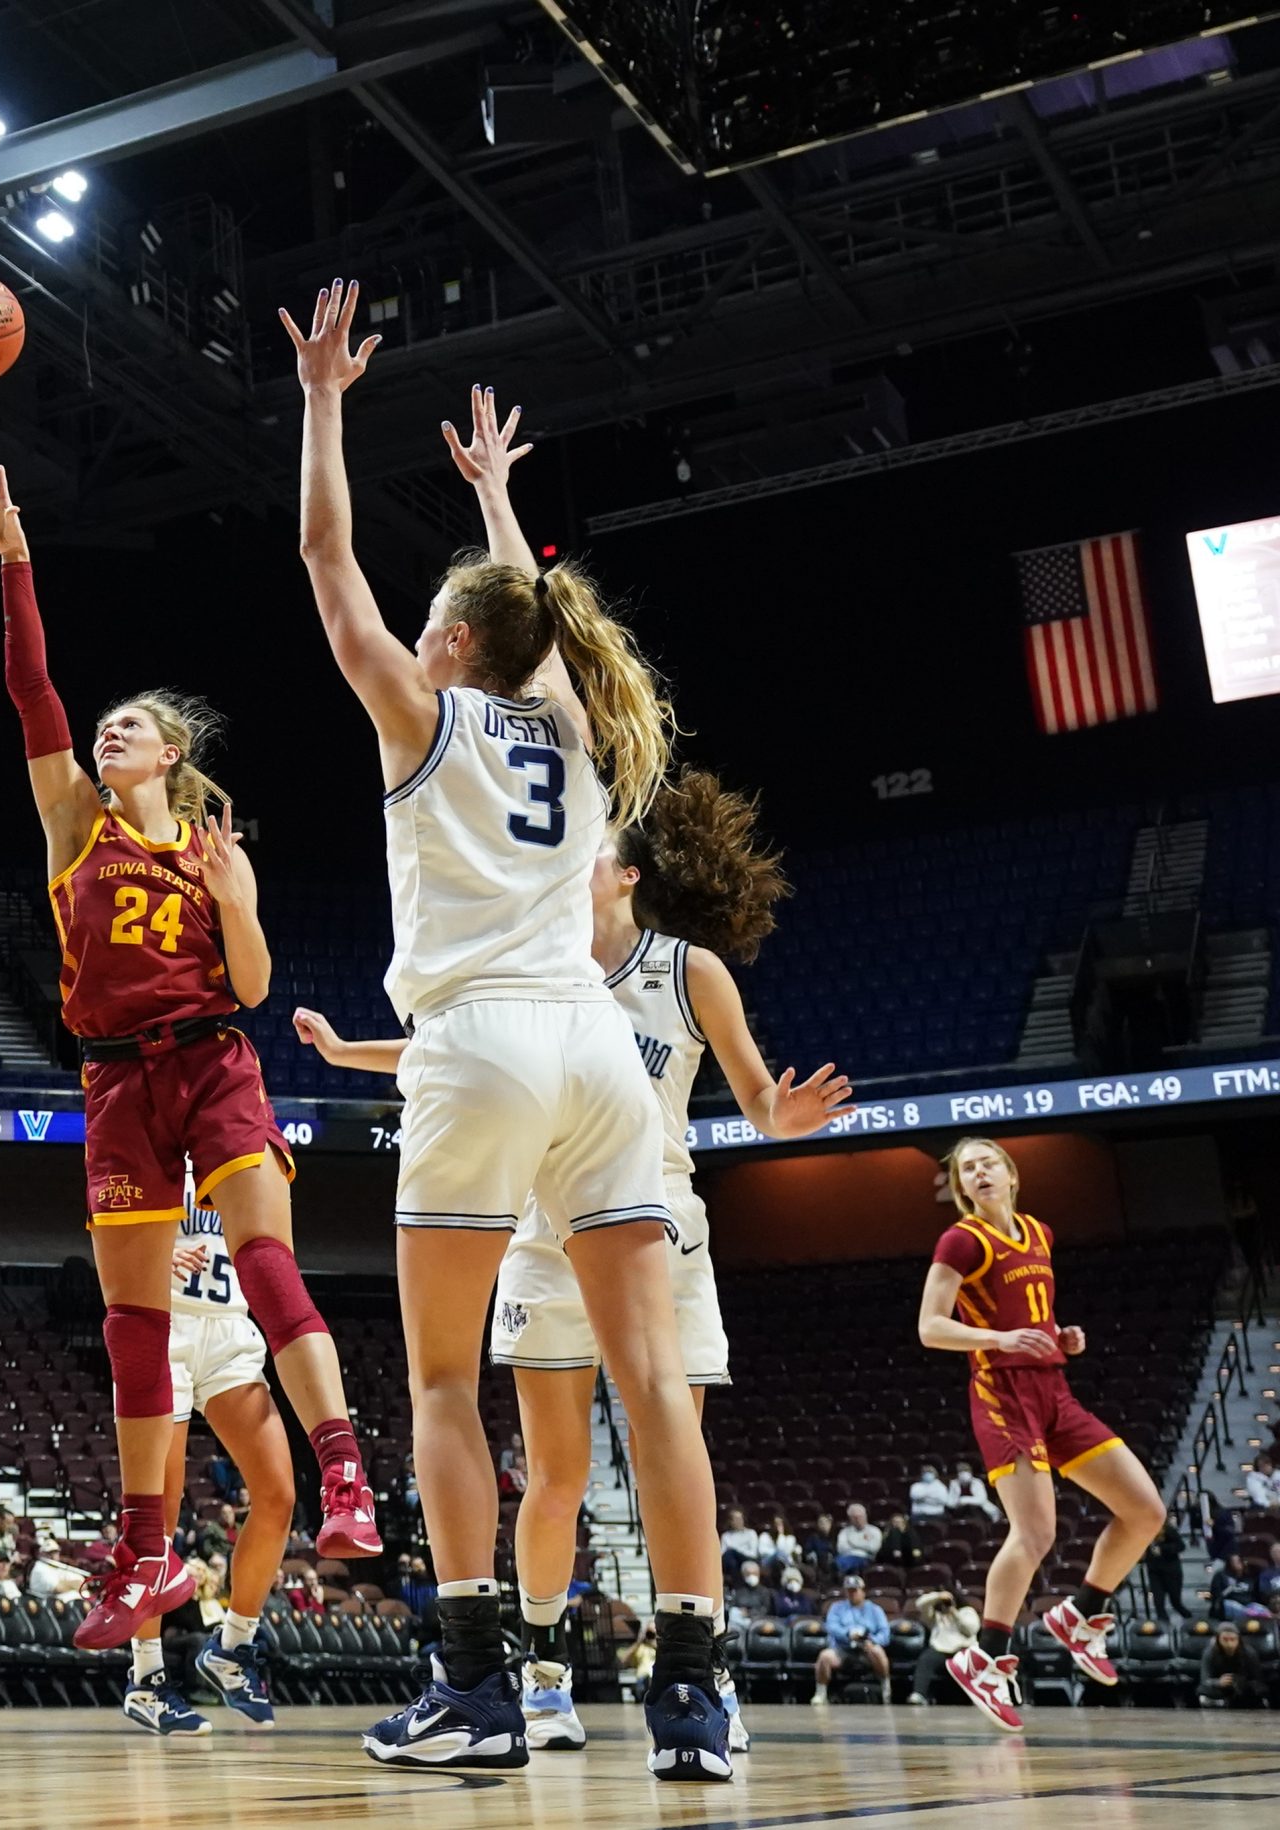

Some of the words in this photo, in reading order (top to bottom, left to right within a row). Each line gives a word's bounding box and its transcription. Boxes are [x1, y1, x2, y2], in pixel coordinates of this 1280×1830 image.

[506, 743, 566, 848] 3
[871, 768, 933, 799] 122
[98, 862, 148, 880] IOWA
[151, 865, 204, 906] STATE
[110, 886, 184, 953] 24
[903, 1102, 920, 1126] 8
[951, 1094, 1013, 1121] FGM:
[1023, 1089, 1054, 1115] 19
[1078, 1083, 1140, 1109] FGA:
[1148, 1075, 1182, 1101] 49
[1213, 1067, 1280, 1096] FTM:
[282, 1122, 313, 1145] 40
[97, 1184, 144, 1203] STATE
[183, 1253, 232, 1304] 15
[1026, 1282, 1050, 1323] 11
[681, 1751, 695, 1763] 07
